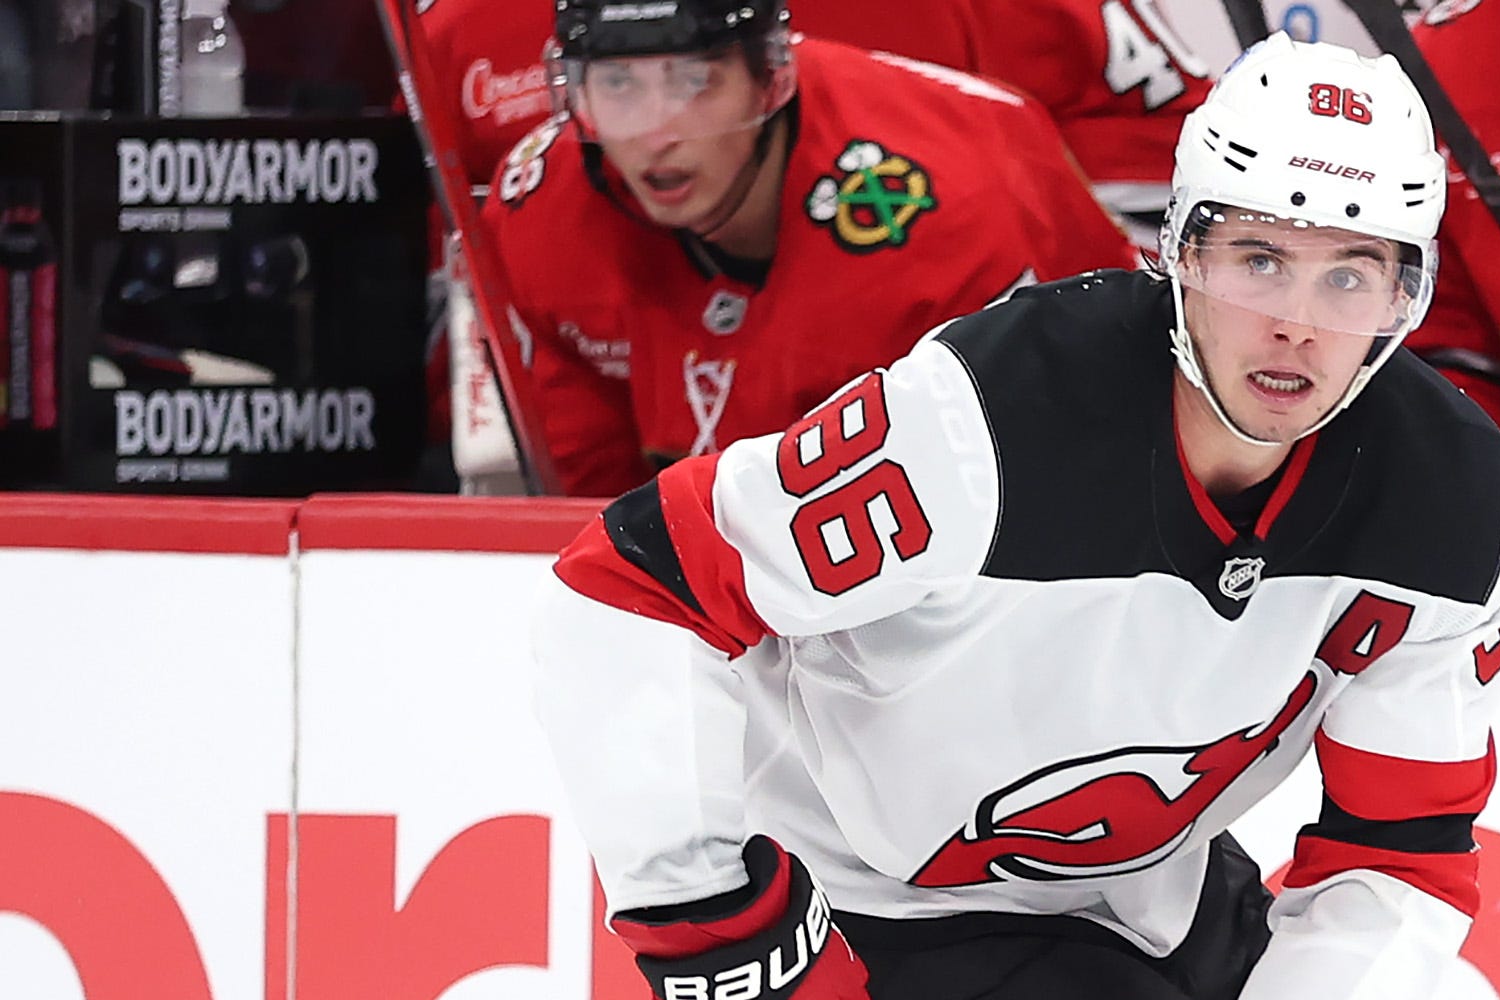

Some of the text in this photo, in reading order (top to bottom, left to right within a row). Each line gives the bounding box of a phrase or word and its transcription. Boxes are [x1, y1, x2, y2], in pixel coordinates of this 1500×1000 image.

[1308, 83, 1373, 125] 86
[117, 138, 379, 204] BODYARMOR
[1288, 155, 1377, 184] BAUER
[114, 388, 375, 455] BODYARMOR
[776, 370, 933, 597] 86
